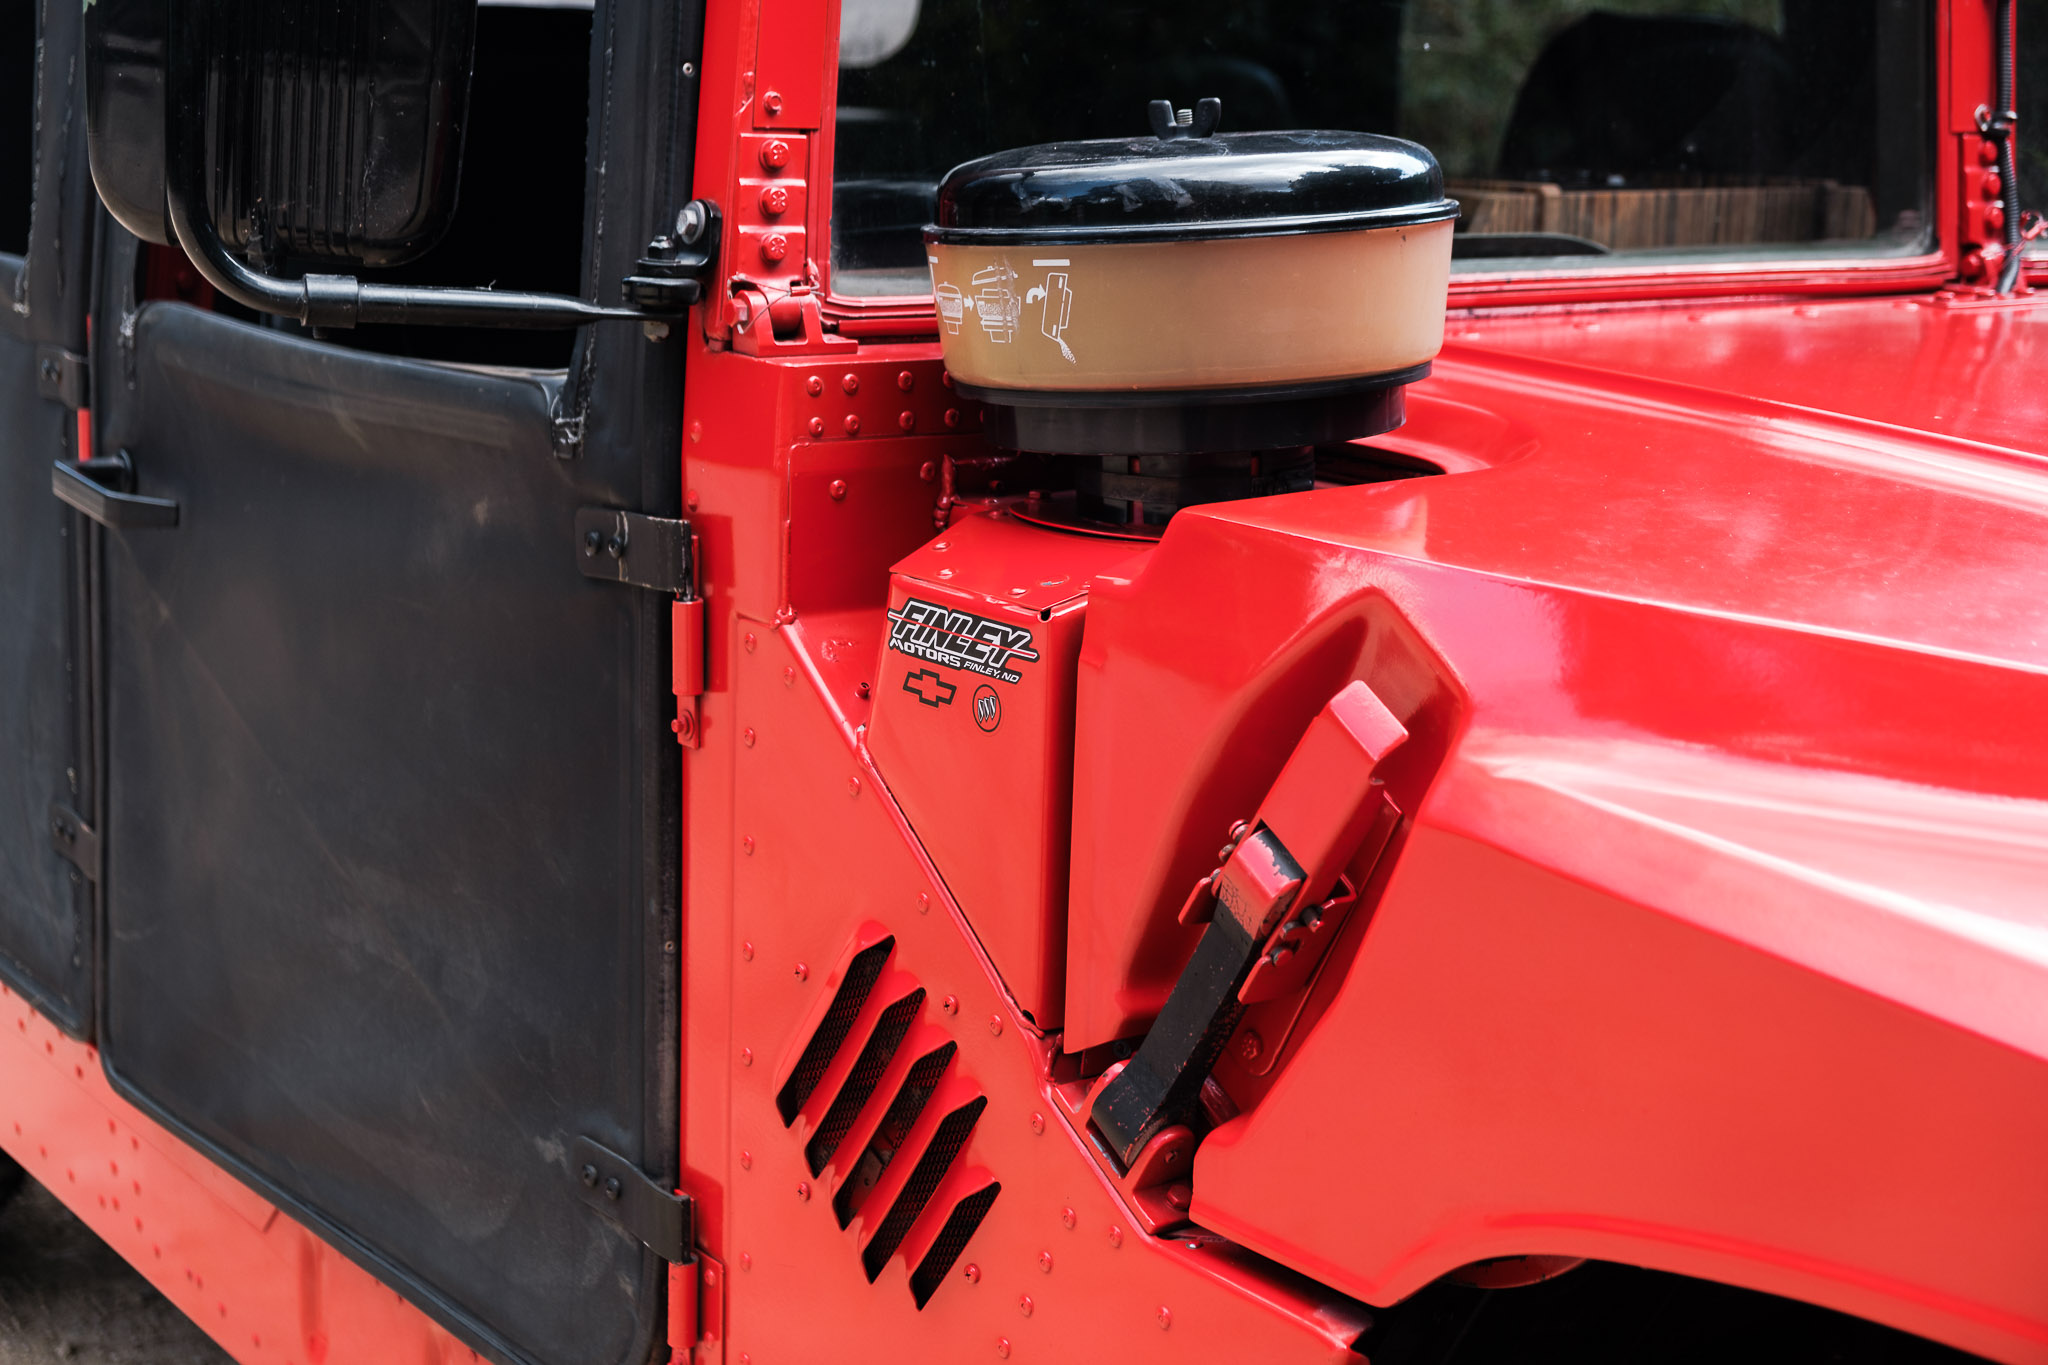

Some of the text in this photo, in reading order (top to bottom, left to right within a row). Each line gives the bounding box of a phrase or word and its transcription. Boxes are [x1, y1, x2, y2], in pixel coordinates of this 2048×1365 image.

[889, 600, 1036, 668] FINLEY
[889, 638, 961, 668] MOTORS
[963, 661, 1020, 683] FINLEY, ND
